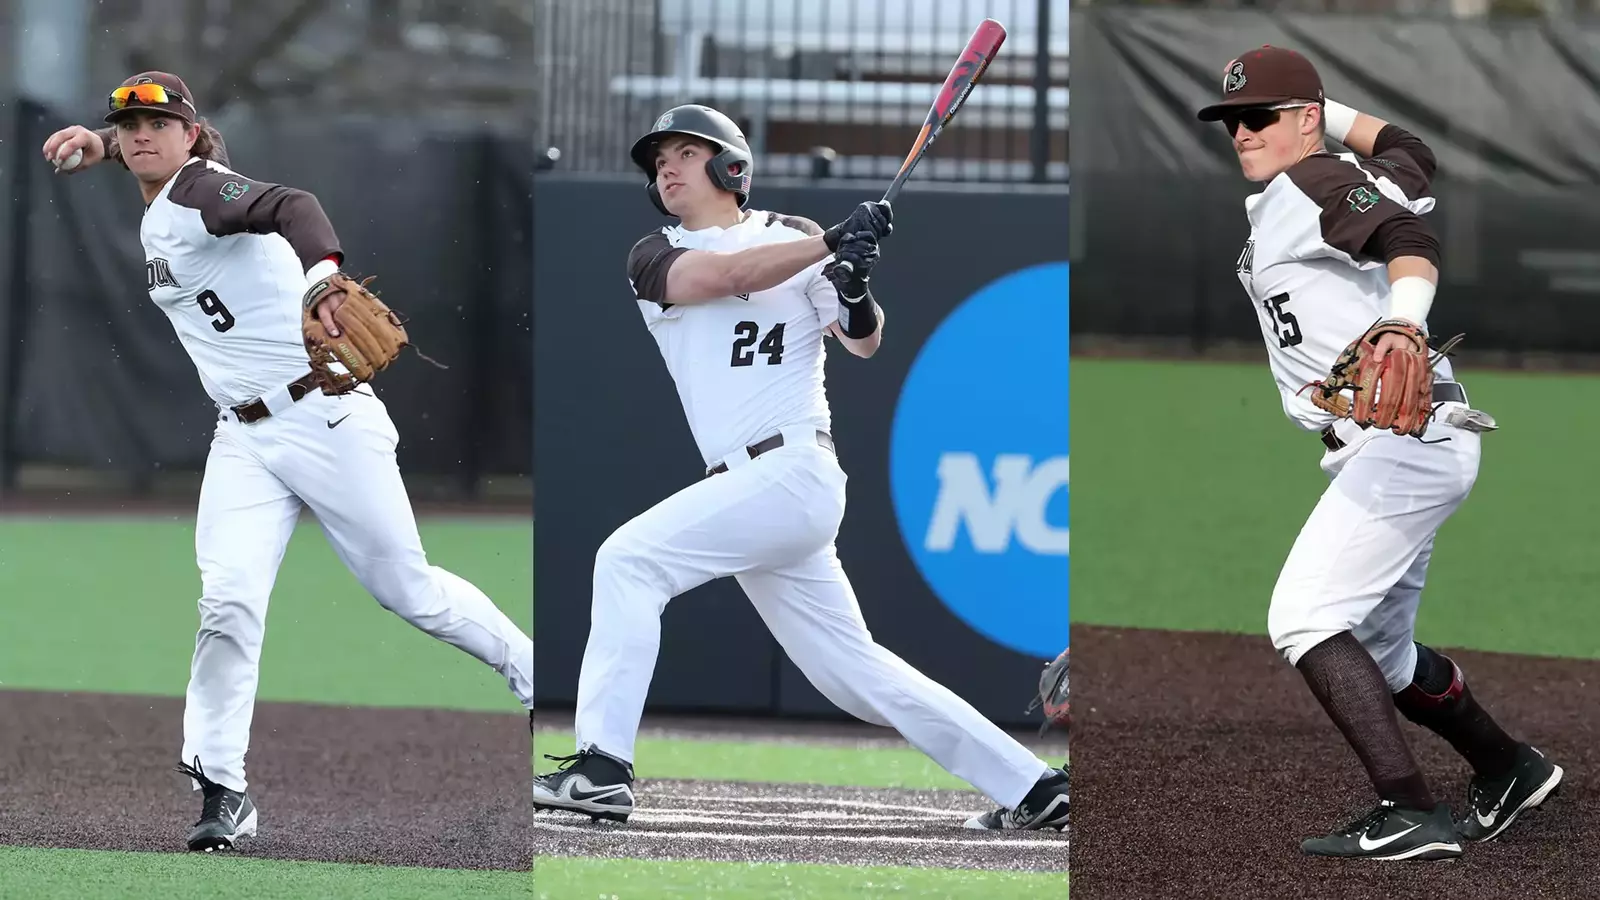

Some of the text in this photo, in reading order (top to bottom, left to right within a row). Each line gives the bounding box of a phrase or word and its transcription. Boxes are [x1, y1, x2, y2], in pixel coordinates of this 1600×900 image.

[196, 289, 236, 333] 9
[1263, 292, 1303, 348] 15
[730, 321, 786, 367] 24
